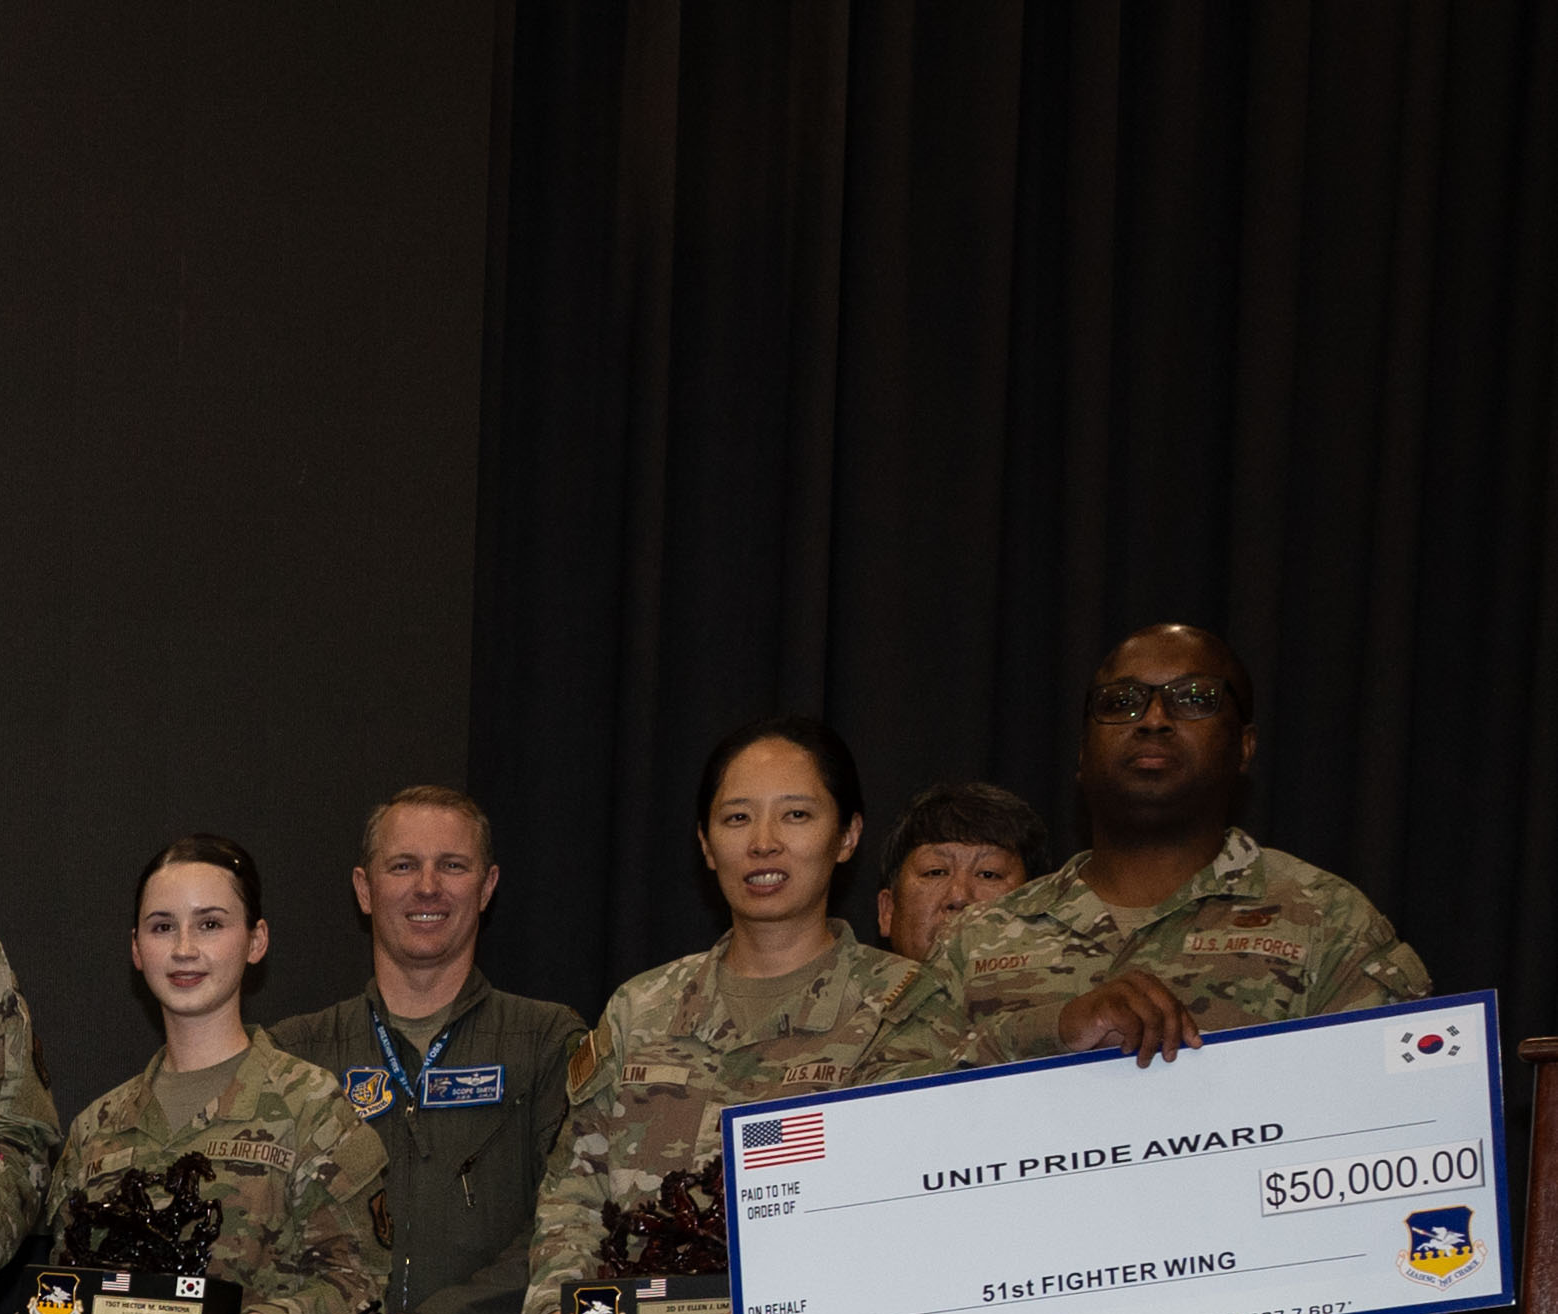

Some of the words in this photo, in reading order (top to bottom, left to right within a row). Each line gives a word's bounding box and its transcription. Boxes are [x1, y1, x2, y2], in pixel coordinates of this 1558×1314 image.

[1192, 936, 1219, 951] U.S.
[1224, 936, 1250, 951] AIR
[1254, 937, 1301, 959] FORCE
[974, 955, 1030, 974] MOODY
[623, 1066, 647, 1082] LIM
[813, 1064, 834, 1081] AIR
[207, 1142, 228, 1157] U.S.
[230, 1143, 251, 1160] AIR
[253, 1145, 293, 1169] FORCE
[923, 1163, 1007, 1191] UNIT
[1019, 1144, 1133, 1178] PRIDE
[1143, 1123, 1285, 1160] AWARD
[1265, 1147, 1478, 1210] $50,000.00
[741, 1187, 764, 1202] PAID
[765, 1184, 779, 1199] TO
[781, 1181, 801, 1196] THE
[747, 1203, 781, 1220] ORDER
[783, 1200, 796, 1215] OF
[982, 1279, 1035, 1302] 51st
[1041, 1262, 1158, 1294] FIGHTER
[1164, 1251, 1236, 1278] WING
[122, 1302, 146, 1310] HECTOR
